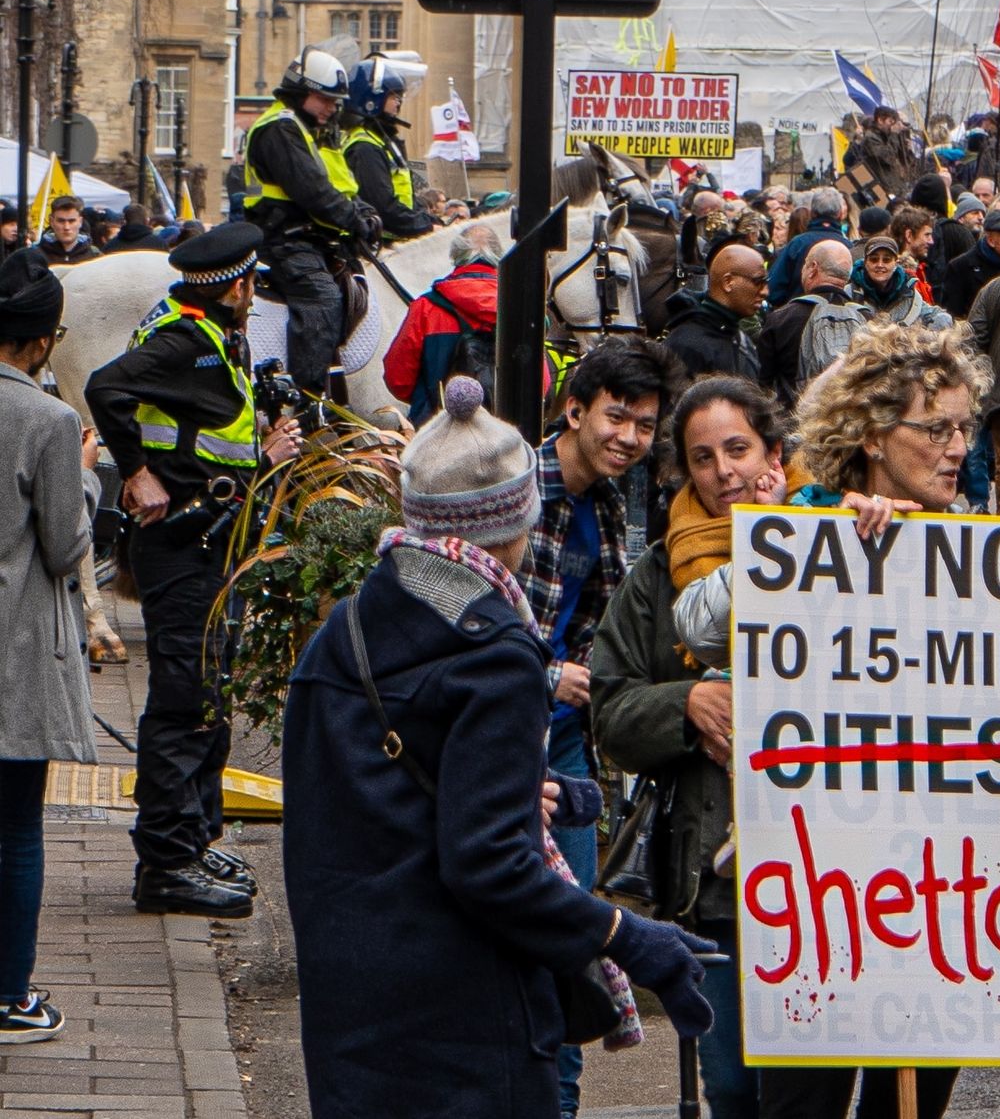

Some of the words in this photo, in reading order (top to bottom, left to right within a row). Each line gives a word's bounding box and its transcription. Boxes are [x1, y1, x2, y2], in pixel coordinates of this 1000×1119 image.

[575, 75, 615, 95] SAY
[620, 72, 655, 96] NO
[661, 77, 685, 97] TO
[692, 78, 730, 98] THE
[571, 96, 610, 118] NEW
[614, 97, 673, 120] WORLD
[677, 99, 730, 121] ORDER
[571, 119, 589, 131] SAY
[592, 119, 604, 132] NO
[606, 119, 618, 132] TO
[621, 120, 633, 132] 15
[636, 120, 660, 133] MINS
[663, 121, 698, 134] PRISON
[700, 122, 730, 135] CITIES
[626, 136, 671, 155] PEOPLE
[679, 137, 730, 157] WAKEUP
[746, 515, 905, 597] SAY
[738, 621, 808, 681] TO
